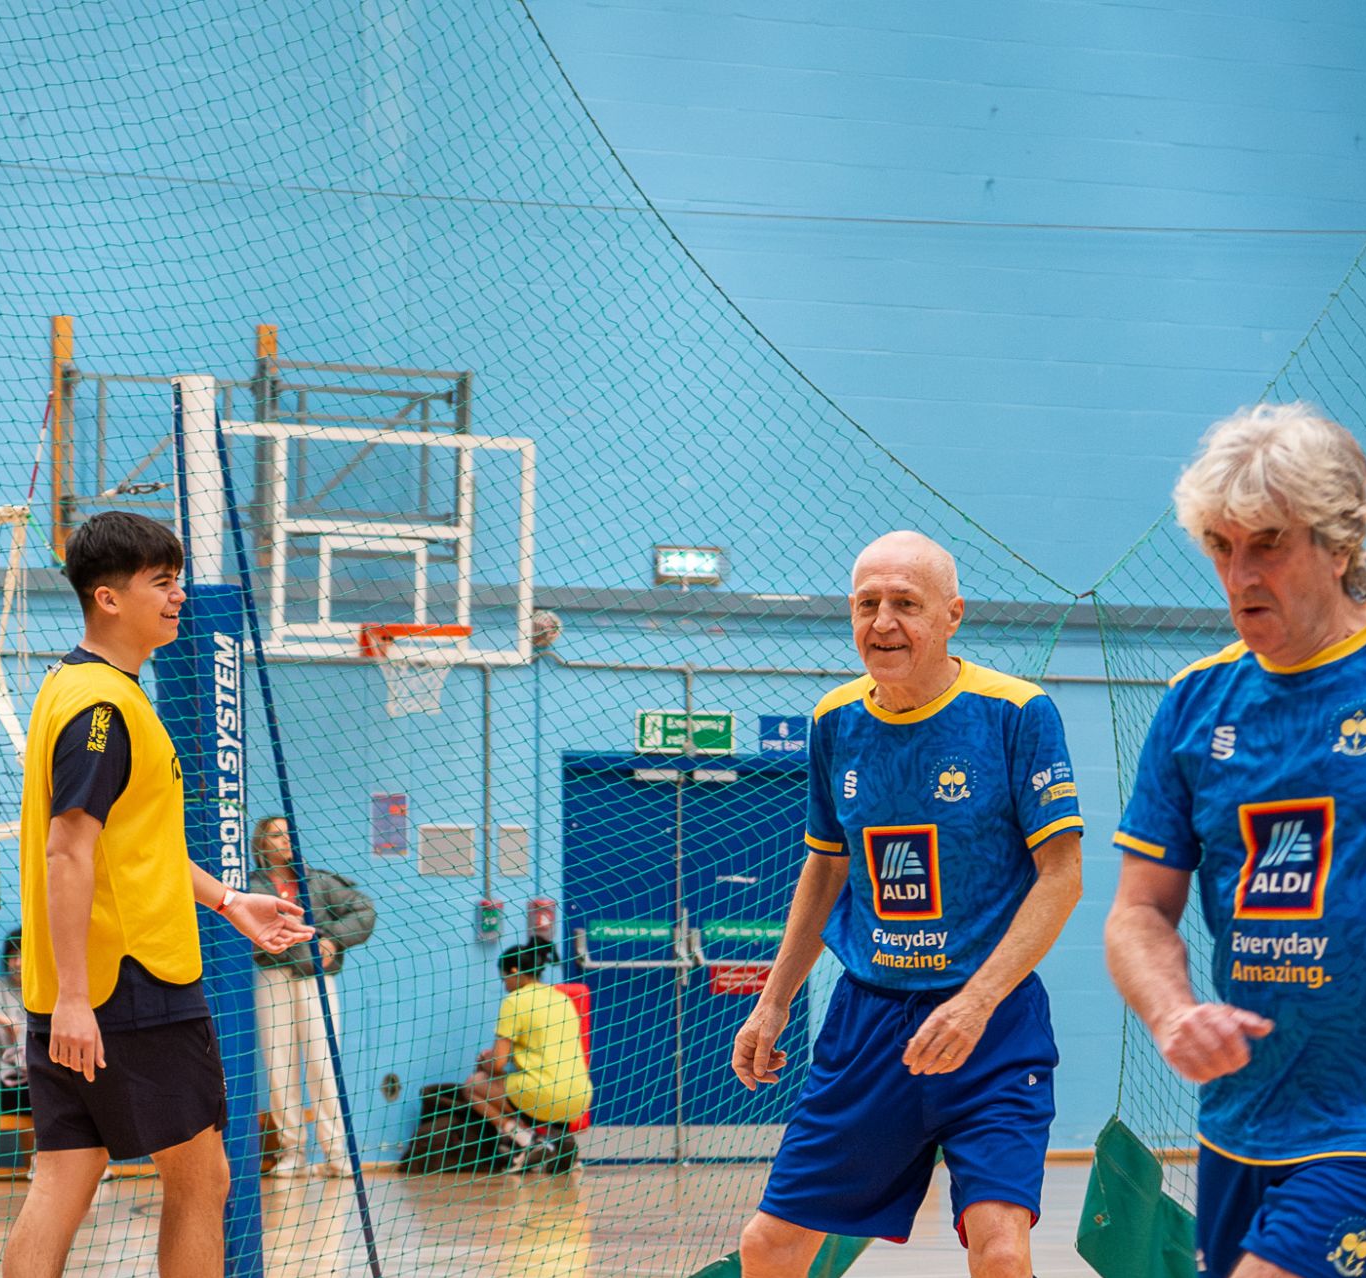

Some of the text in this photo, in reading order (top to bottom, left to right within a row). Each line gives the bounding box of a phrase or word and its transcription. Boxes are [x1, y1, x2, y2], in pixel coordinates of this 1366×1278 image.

[213, 631, 241, 890] SPORT SYSTEM
[882, 883, 927, 900] ALDI
[1250, 872, 1313, 893] ALDI
[872, 928, 948, 951] Everyday
[1231, 931, 1329, 960] Everyday
[871, 949, 952, 971] Amazing.
[1231, 960, 1332, 989] Amazing.
